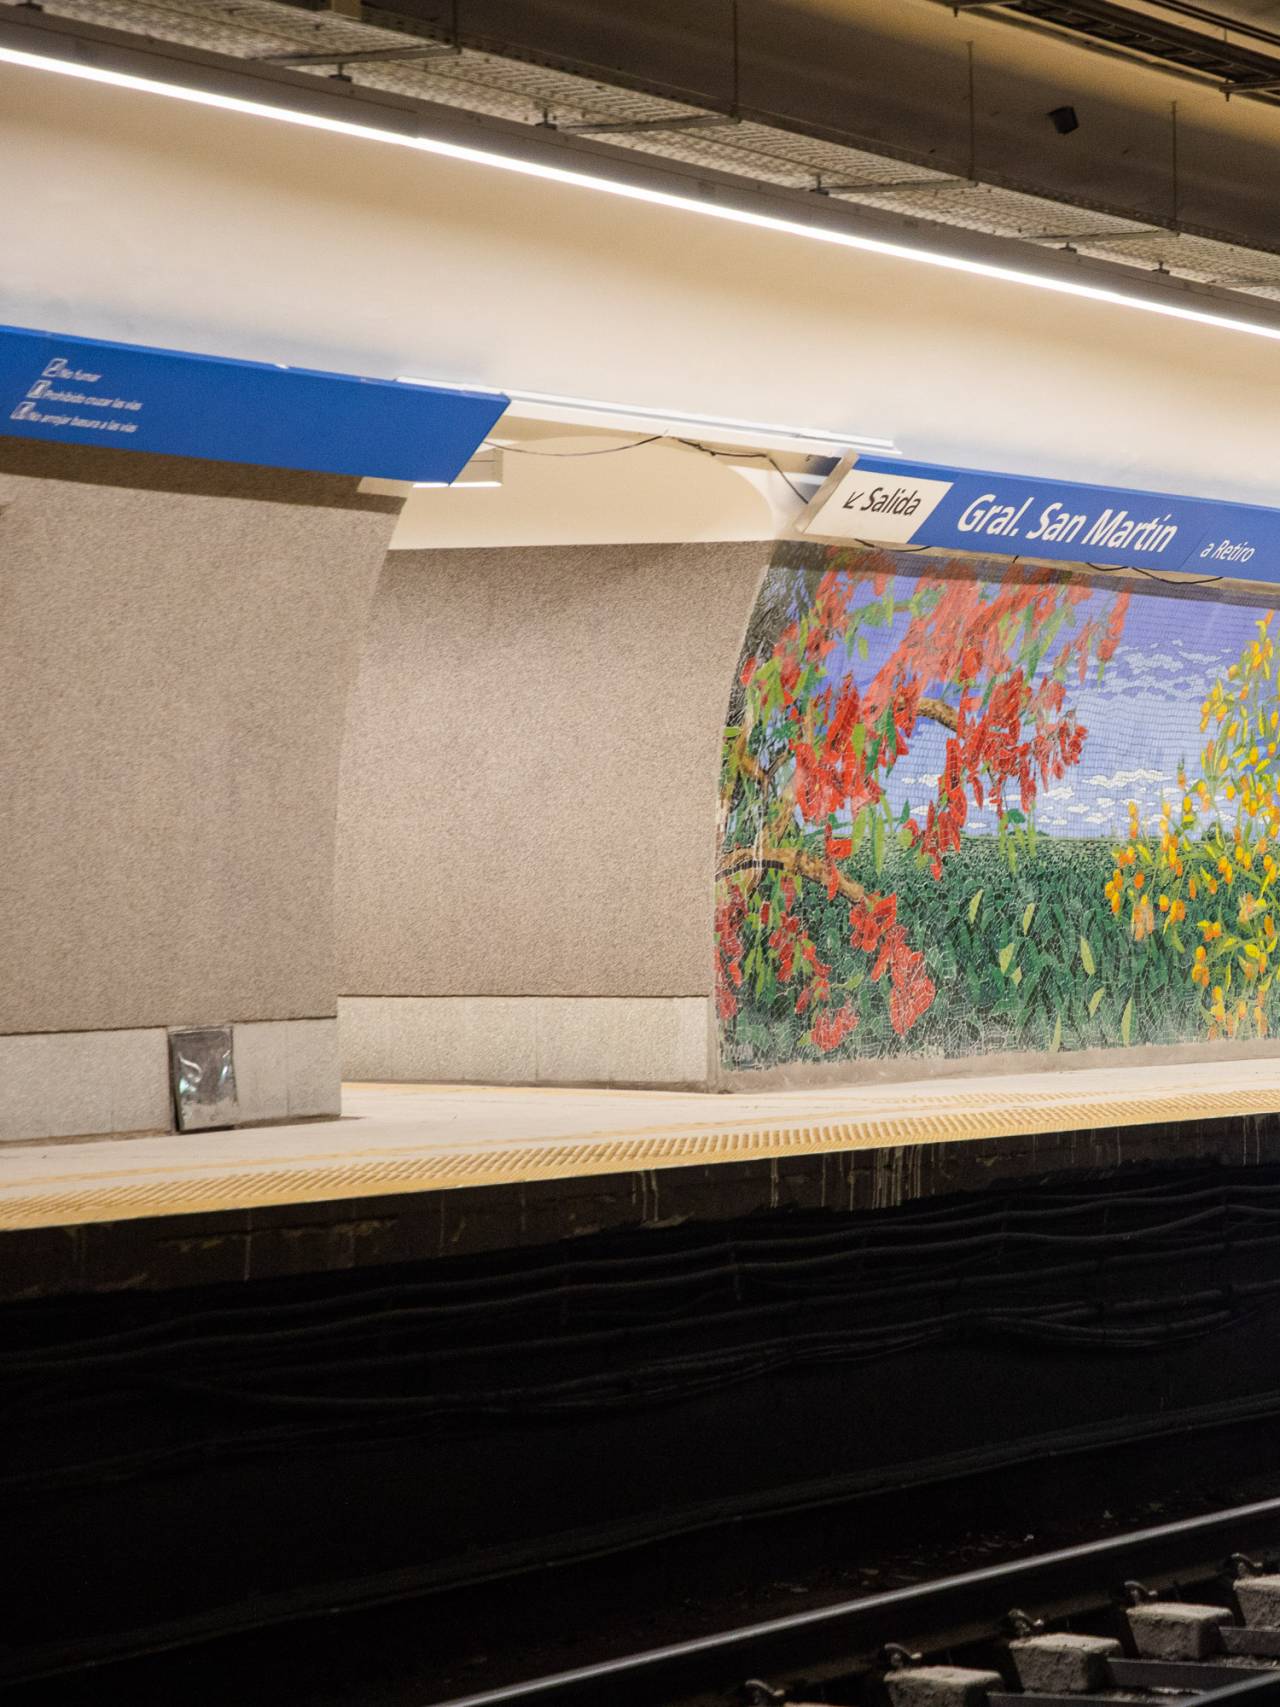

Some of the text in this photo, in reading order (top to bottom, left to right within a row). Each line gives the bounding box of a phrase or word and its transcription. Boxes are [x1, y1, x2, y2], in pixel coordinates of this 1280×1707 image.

[859, 486, 922, 516] Salida
[956, 494, 1180, 552] Gral. San Martín
[1200, 539, 1256, 563] a Retiro
